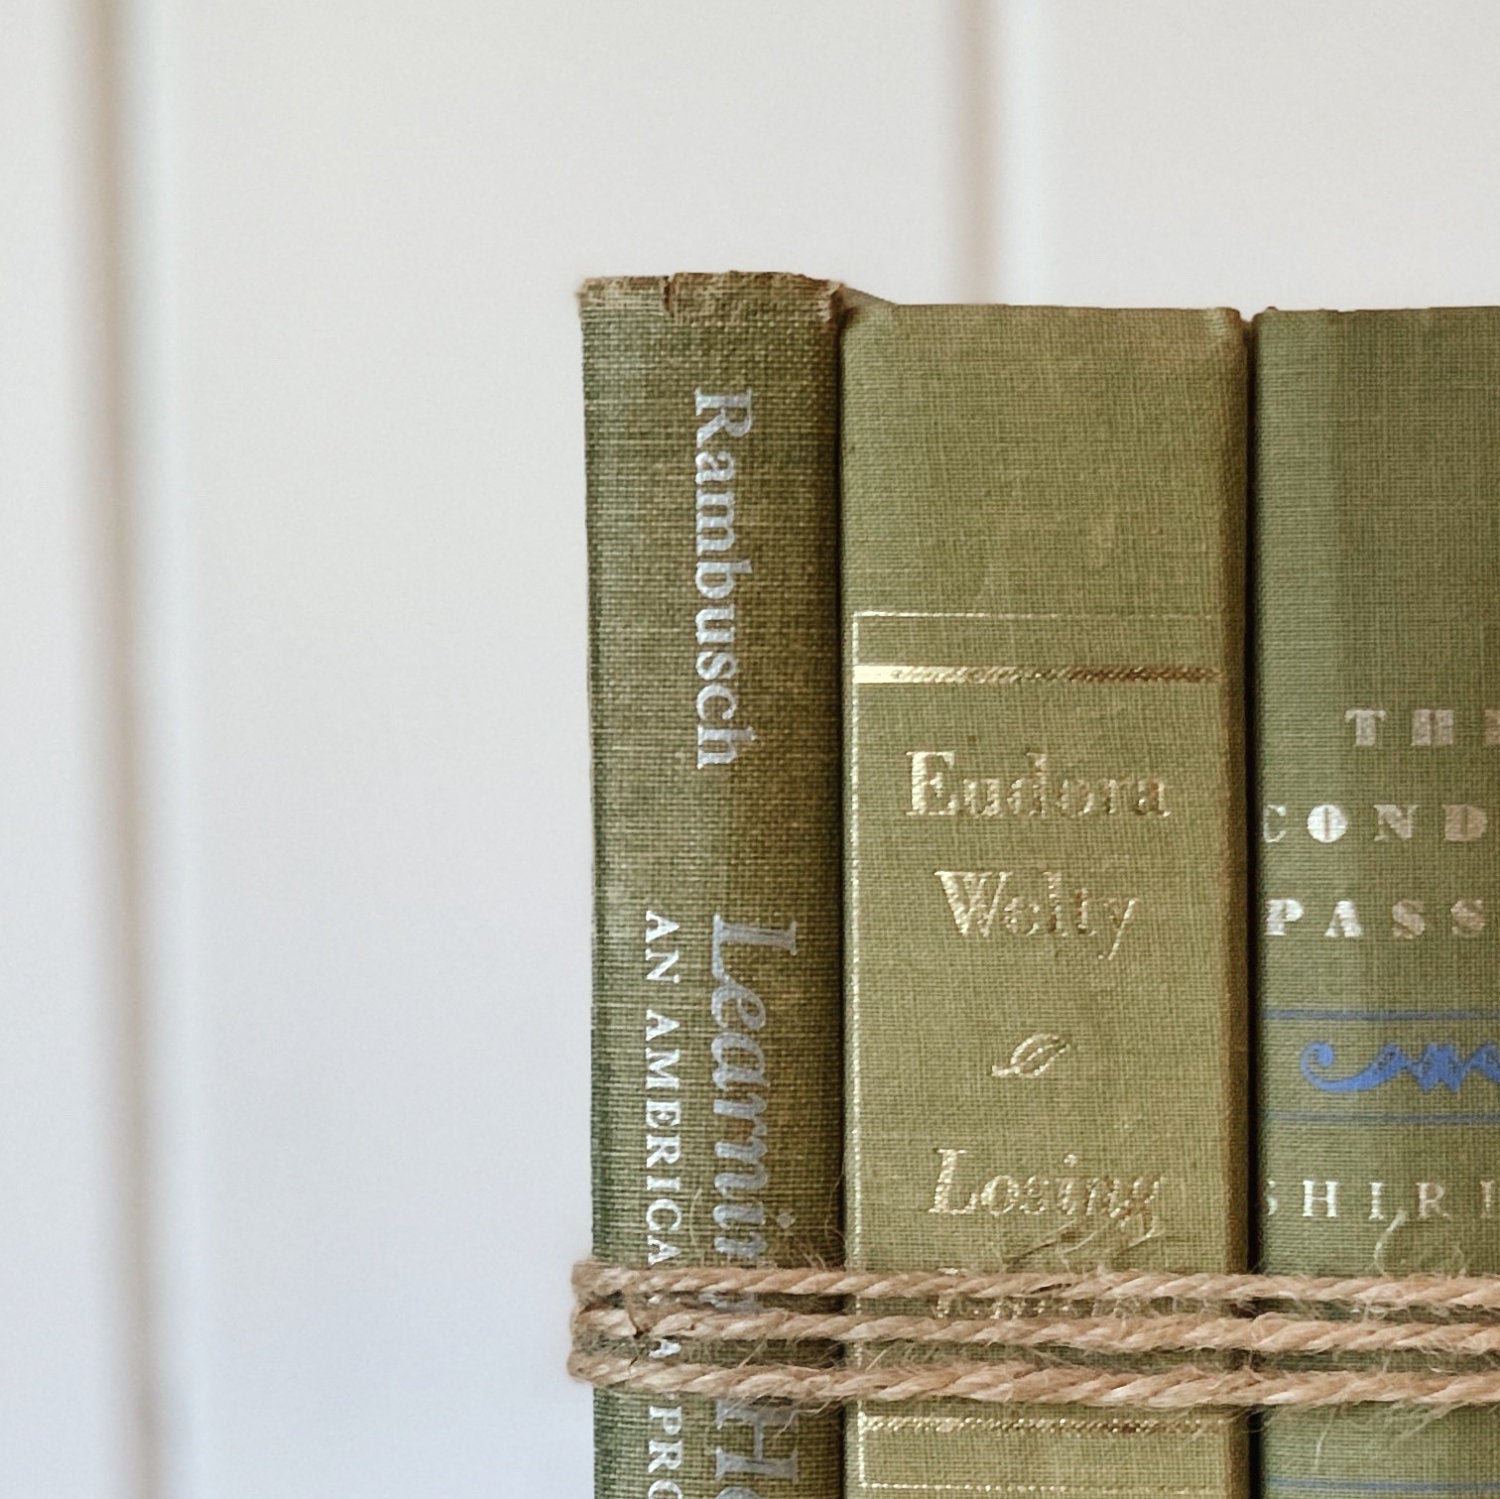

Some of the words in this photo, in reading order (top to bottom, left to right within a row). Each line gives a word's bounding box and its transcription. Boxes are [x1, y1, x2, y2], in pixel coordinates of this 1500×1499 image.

[693, 388, 756, 770] Rambusch
[904, 749, 1171, 819] Eudora
[643, 910, 682, 985] AN
[933, 869, 1139, 961] Welty
[644, 1008, 683, 1304] AMERICA
[707, 912, 797, 1312] Learni
[926, 1147, 1168, 1241] Losing
